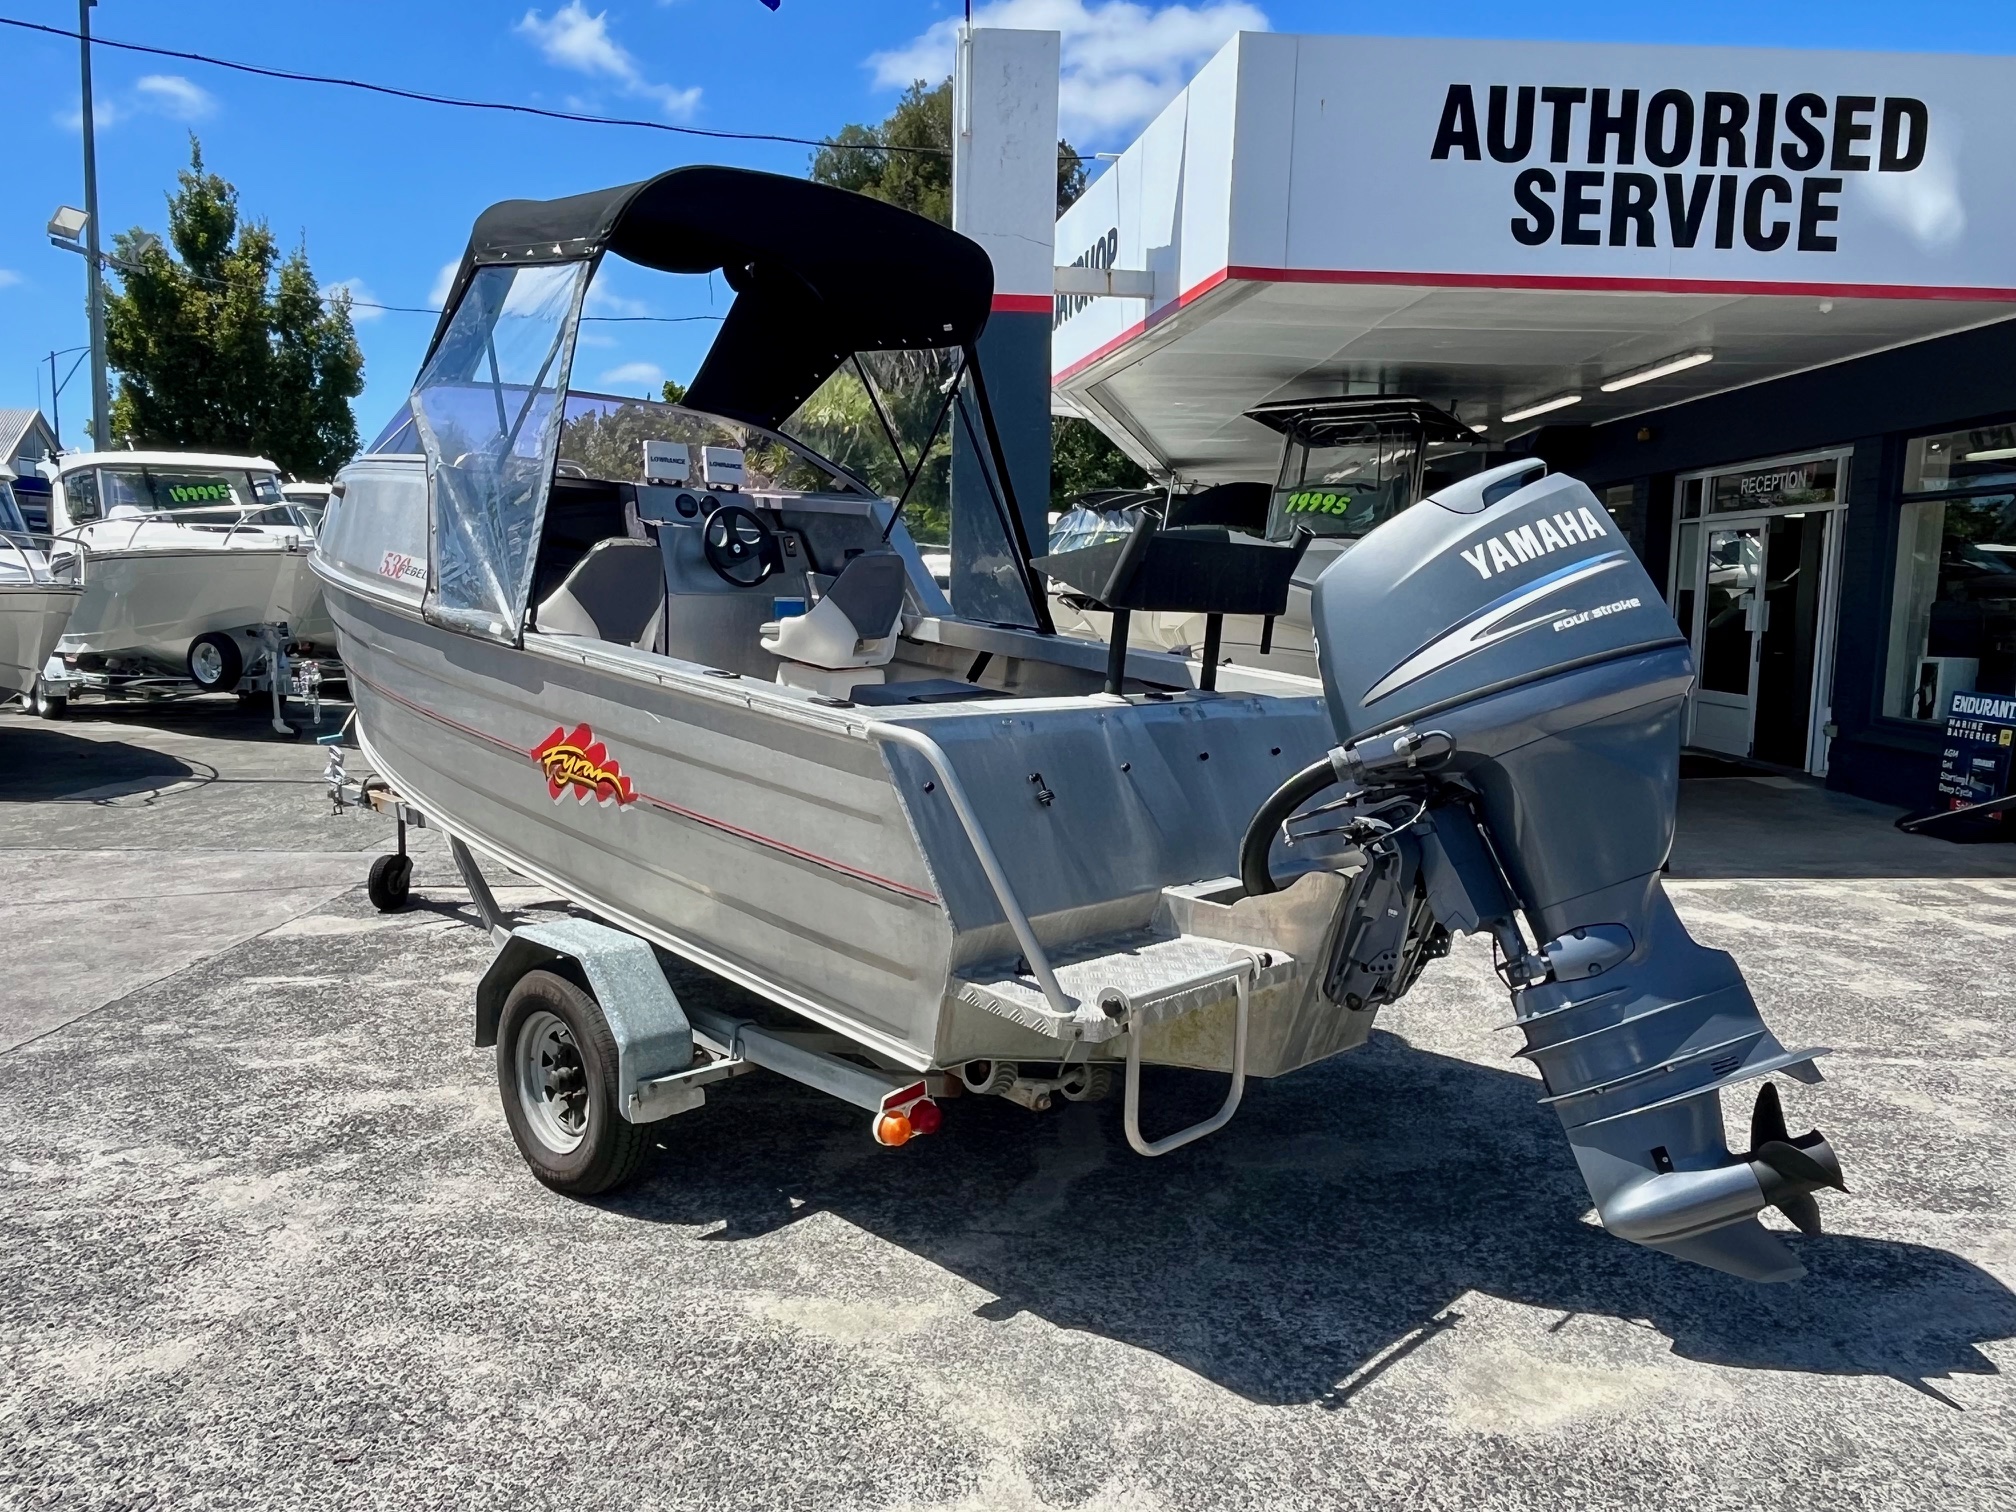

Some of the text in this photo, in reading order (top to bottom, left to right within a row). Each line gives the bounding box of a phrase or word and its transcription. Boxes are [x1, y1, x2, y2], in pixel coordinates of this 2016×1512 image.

[1431, 84, 1928, 172] AUTHORISED
[1511, 168, 1842, 252] SERVICE
[650, 456, 685, 465] LOWRANCE
[709, 461, 743, 470] LOWRANCE
[1741, 469, 1807, 494] RECEPTION
[169, 485, 230, 502] 199995
[1460, 507, 1607, 580] YAMAHA
[380, 553, 411, 579] 536
[1946, 728, 1997, 743] BATTERIES
[1948, 718, 1984, 732] MARINE
